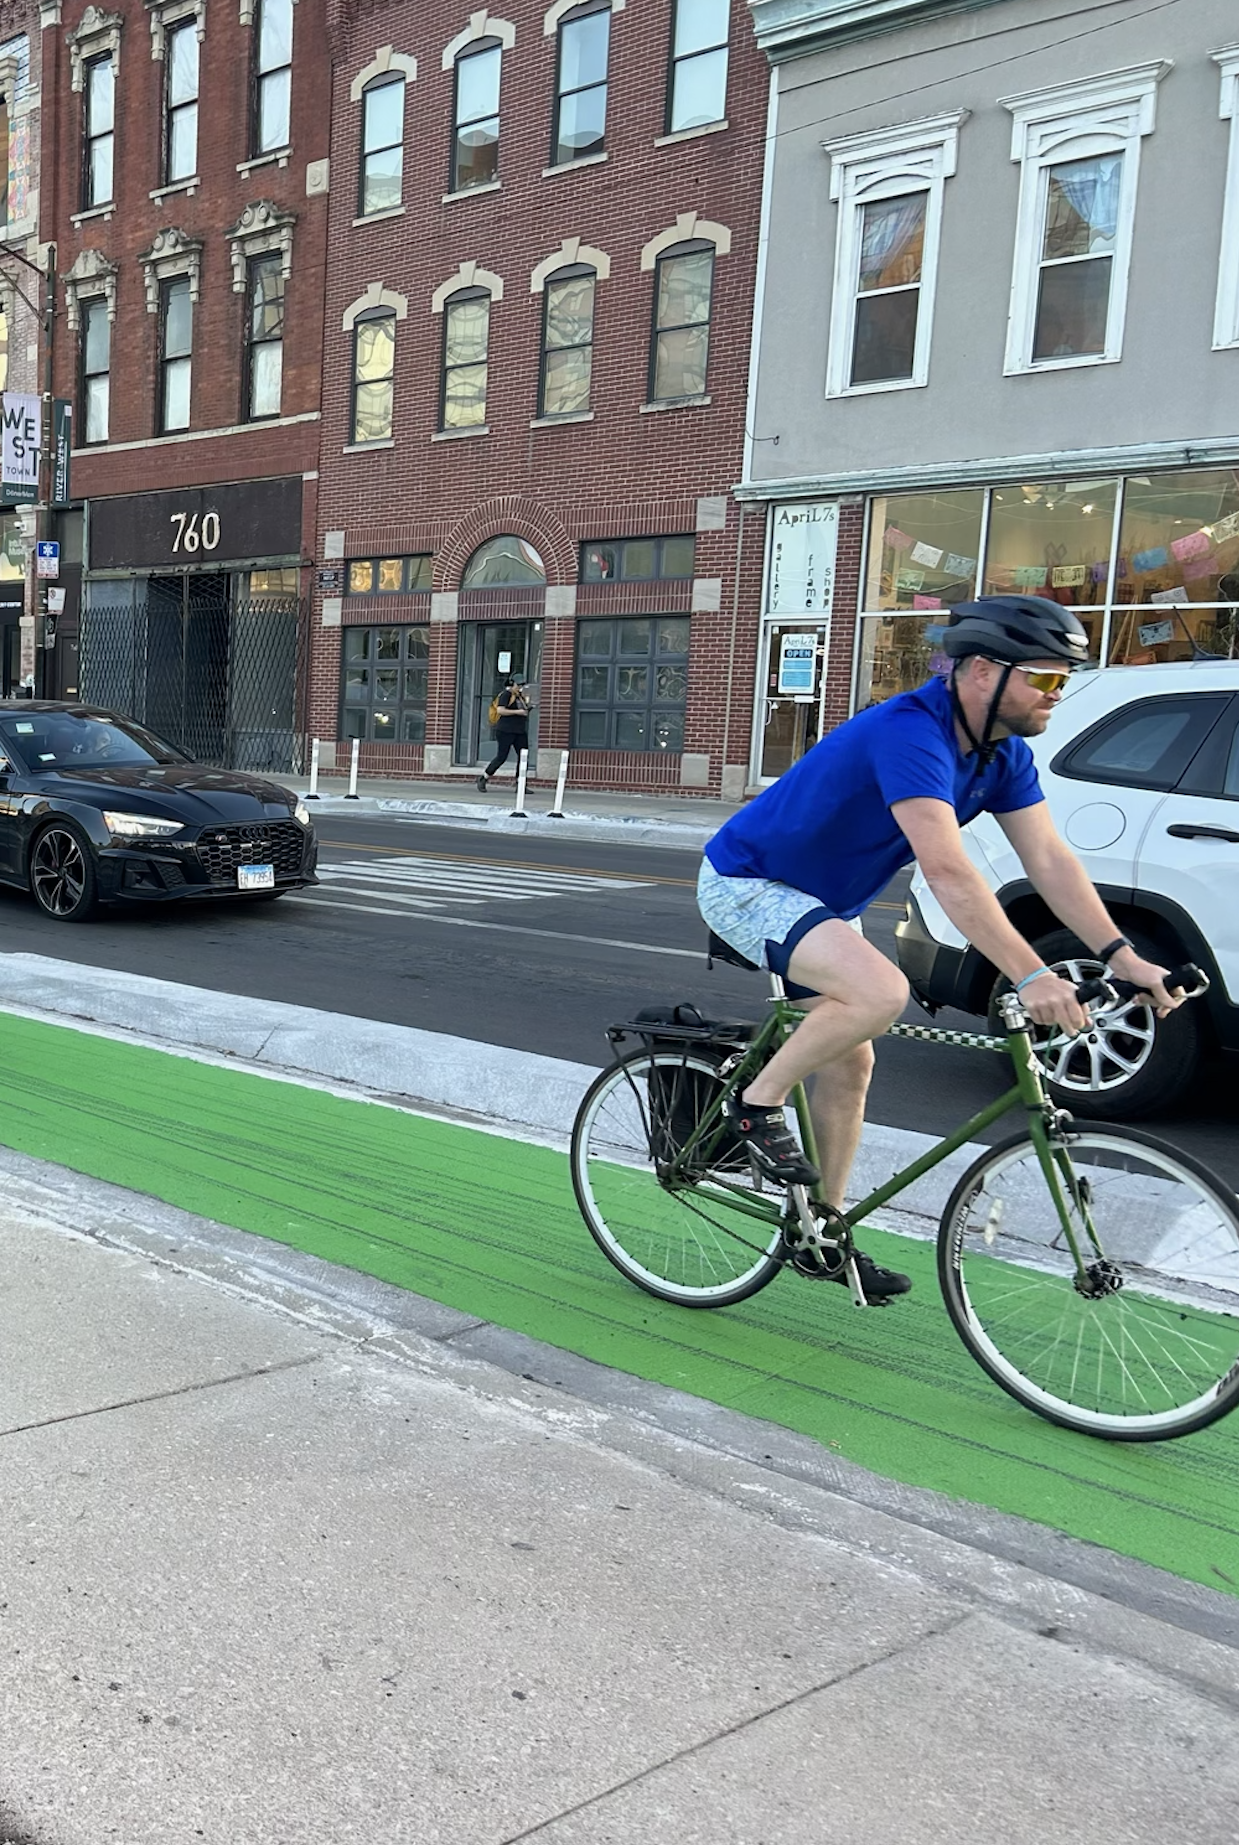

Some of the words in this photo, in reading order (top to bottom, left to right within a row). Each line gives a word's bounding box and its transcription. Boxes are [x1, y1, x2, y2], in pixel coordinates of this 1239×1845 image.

[57, 434, 65, 466] WEST
[6, 466, 31, 476] TOWN
[56, 469, 64, 502] RIVER
[170, 512, 221, 553] 760
[786, 650, 812, 658] OPEN
